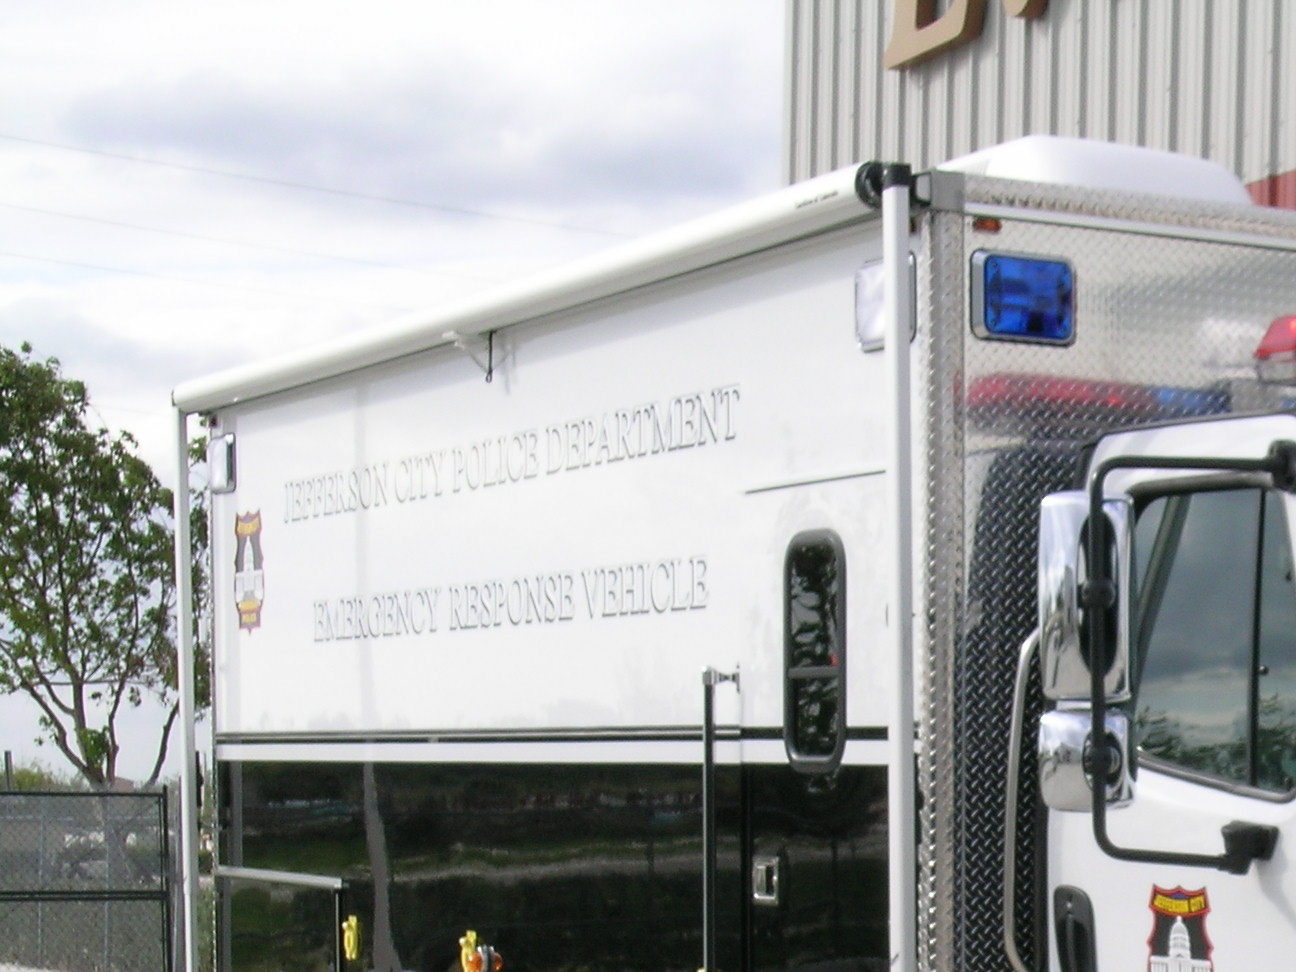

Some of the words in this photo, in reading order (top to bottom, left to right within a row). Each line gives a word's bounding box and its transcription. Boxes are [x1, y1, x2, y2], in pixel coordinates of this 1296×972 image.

[283, 461, 390, 524] JEFFERSON
[394, 448, 447, 504] CITY
[451, 427, 539, 494] POLICE
[545, 384, 741, 476] DEPARTMENT
[313, 585, 442, 643] EMERGENCY
[448, 570, 574, 631] RESPONSE
[580, 555, 708, 619] VEHICLE
